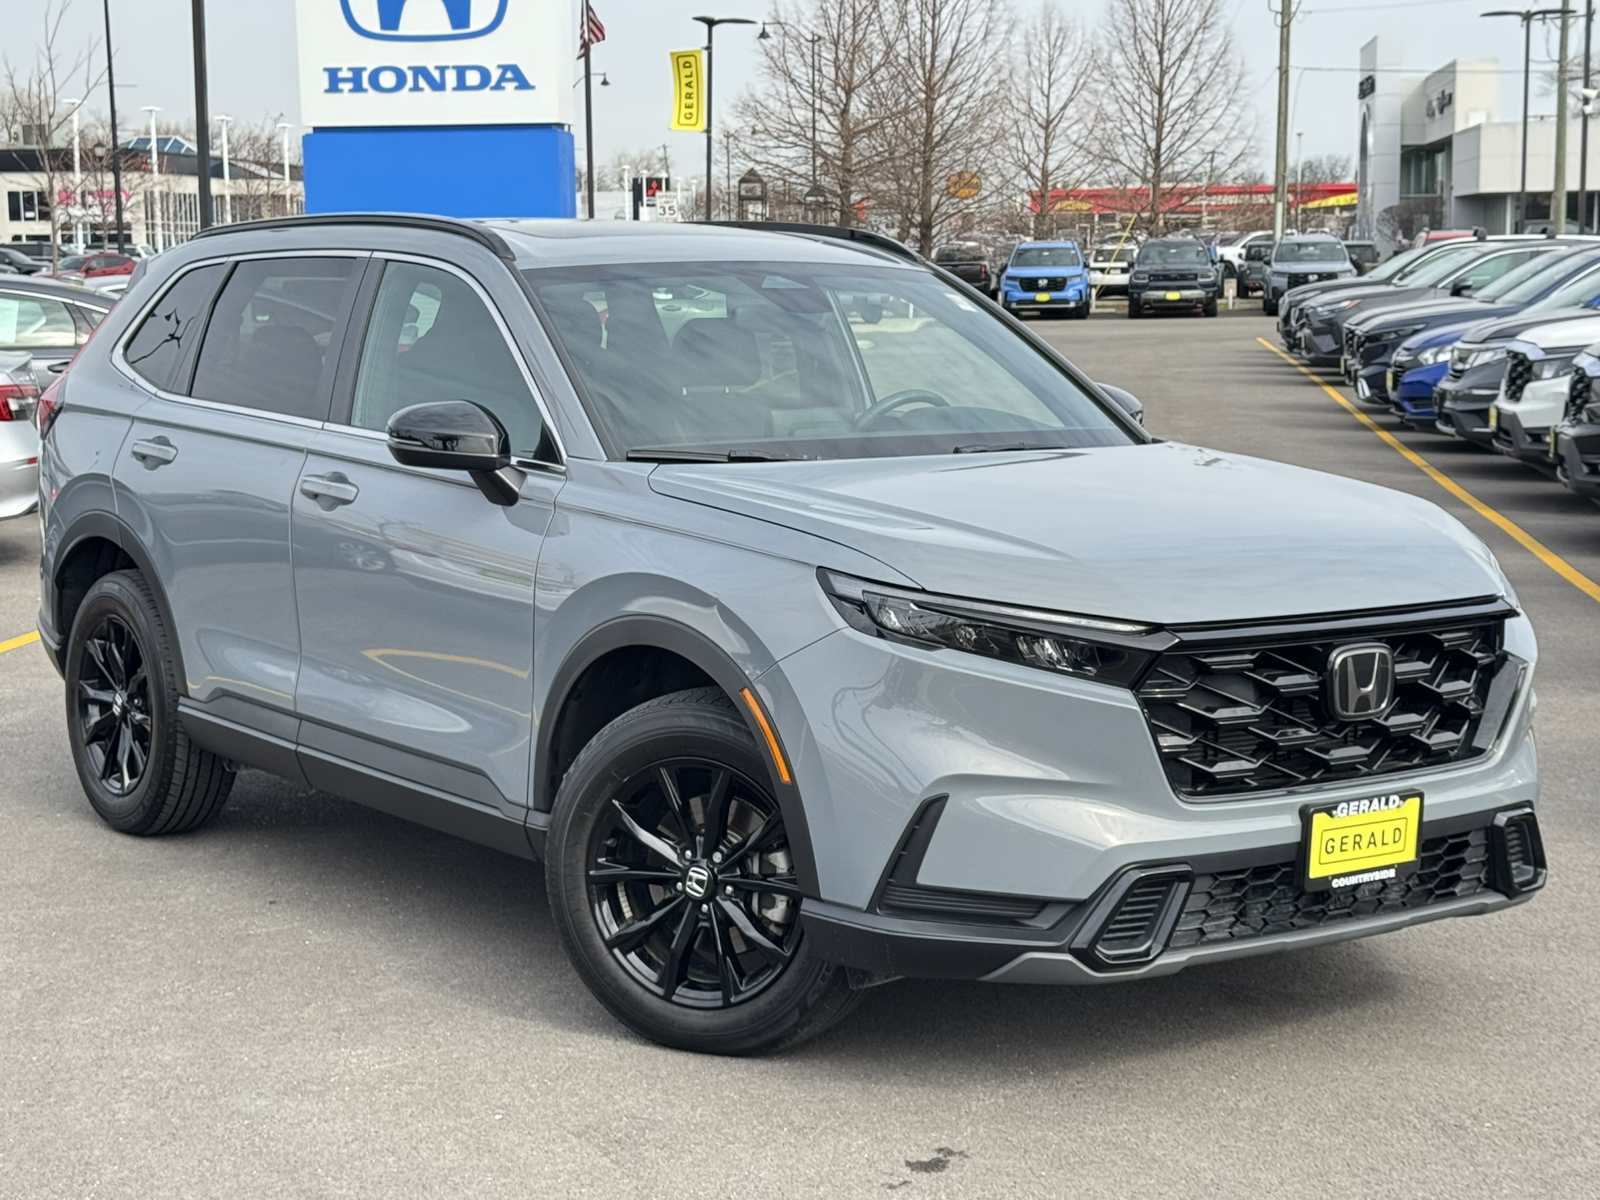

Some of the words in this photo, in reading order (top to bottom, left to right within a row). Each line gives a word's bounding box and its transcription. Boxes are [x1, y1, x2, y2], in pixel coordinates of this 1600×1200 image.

[323, 64, 536, 93] HONDA
[683, 60, 694, 120] GERALD
[659, 205, 676, 216] 35
[1336, 794, 1401, 818] GERALD
[1324, 827, 1403, 855] GERALD
[1331, 867, 1397, 889] COUNTRYSIDE
